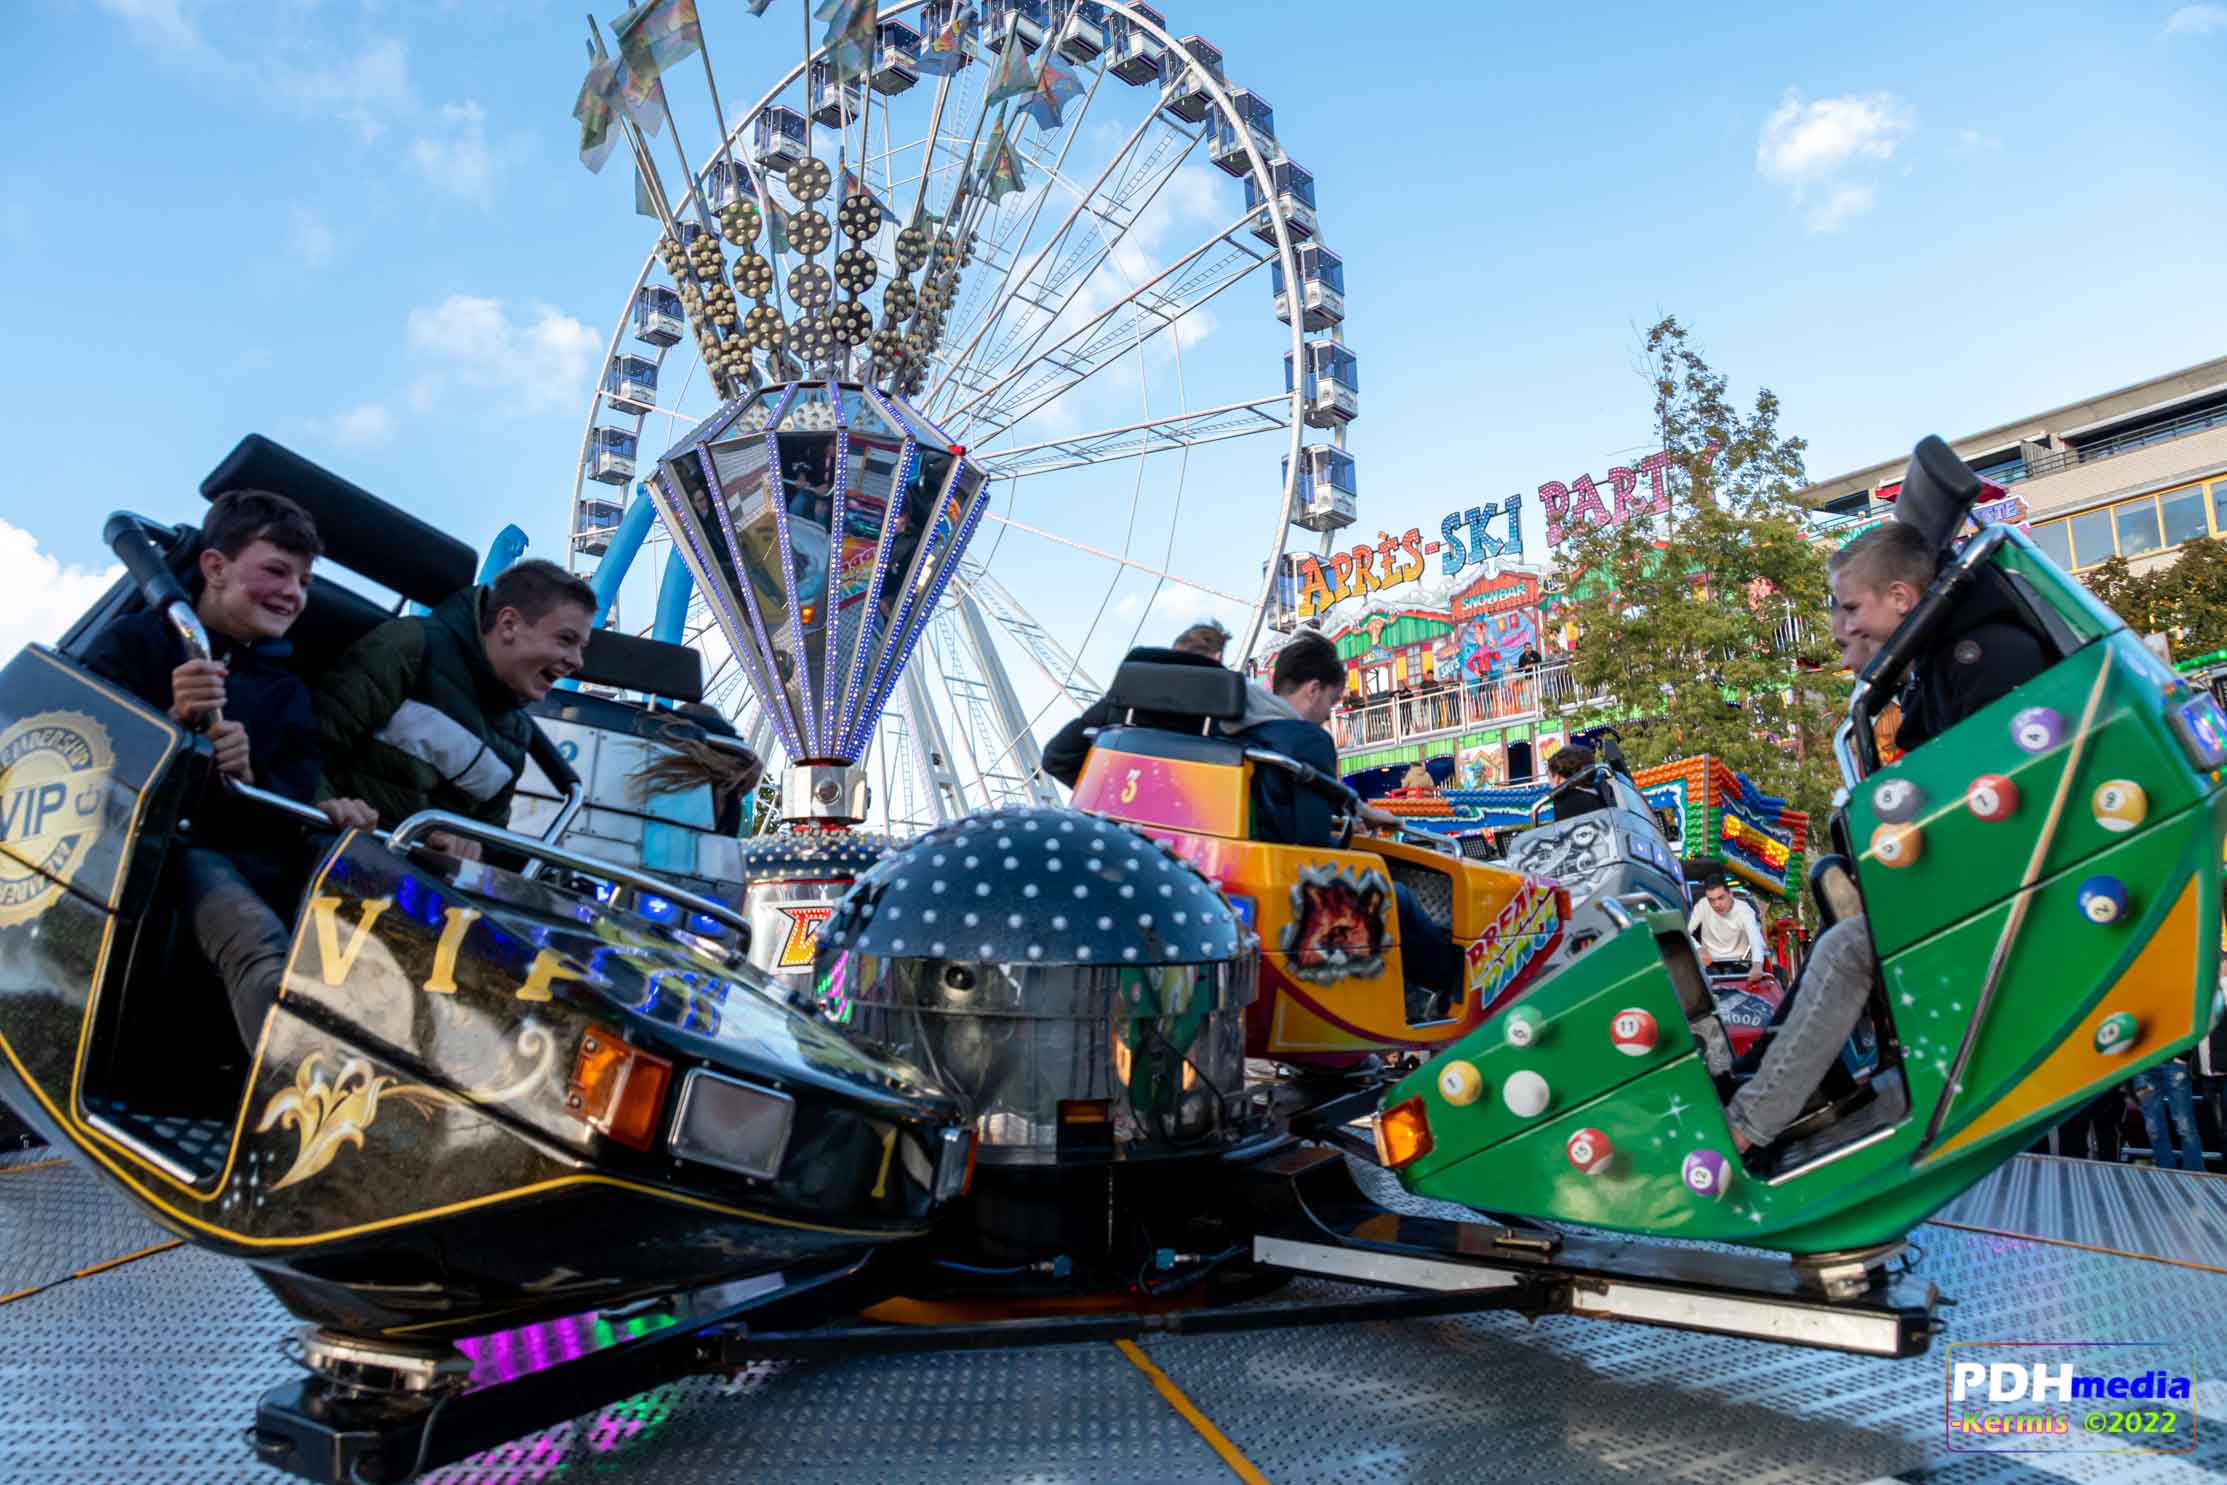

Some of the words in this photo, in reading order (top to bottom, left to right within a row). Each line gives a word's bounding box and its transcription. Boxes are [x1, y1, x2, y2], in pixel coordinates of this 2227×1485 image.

[1461, 583, 1527, 611] SNOWBAR
[1121, 769, 1141, 804] 3
[0, 783, 67, 842] VIP
[311, 896, 612, 1002] VIP
[1481, 890, 1561, 1010] DANCE
[1619, 1021, 1635, 1033] 11
